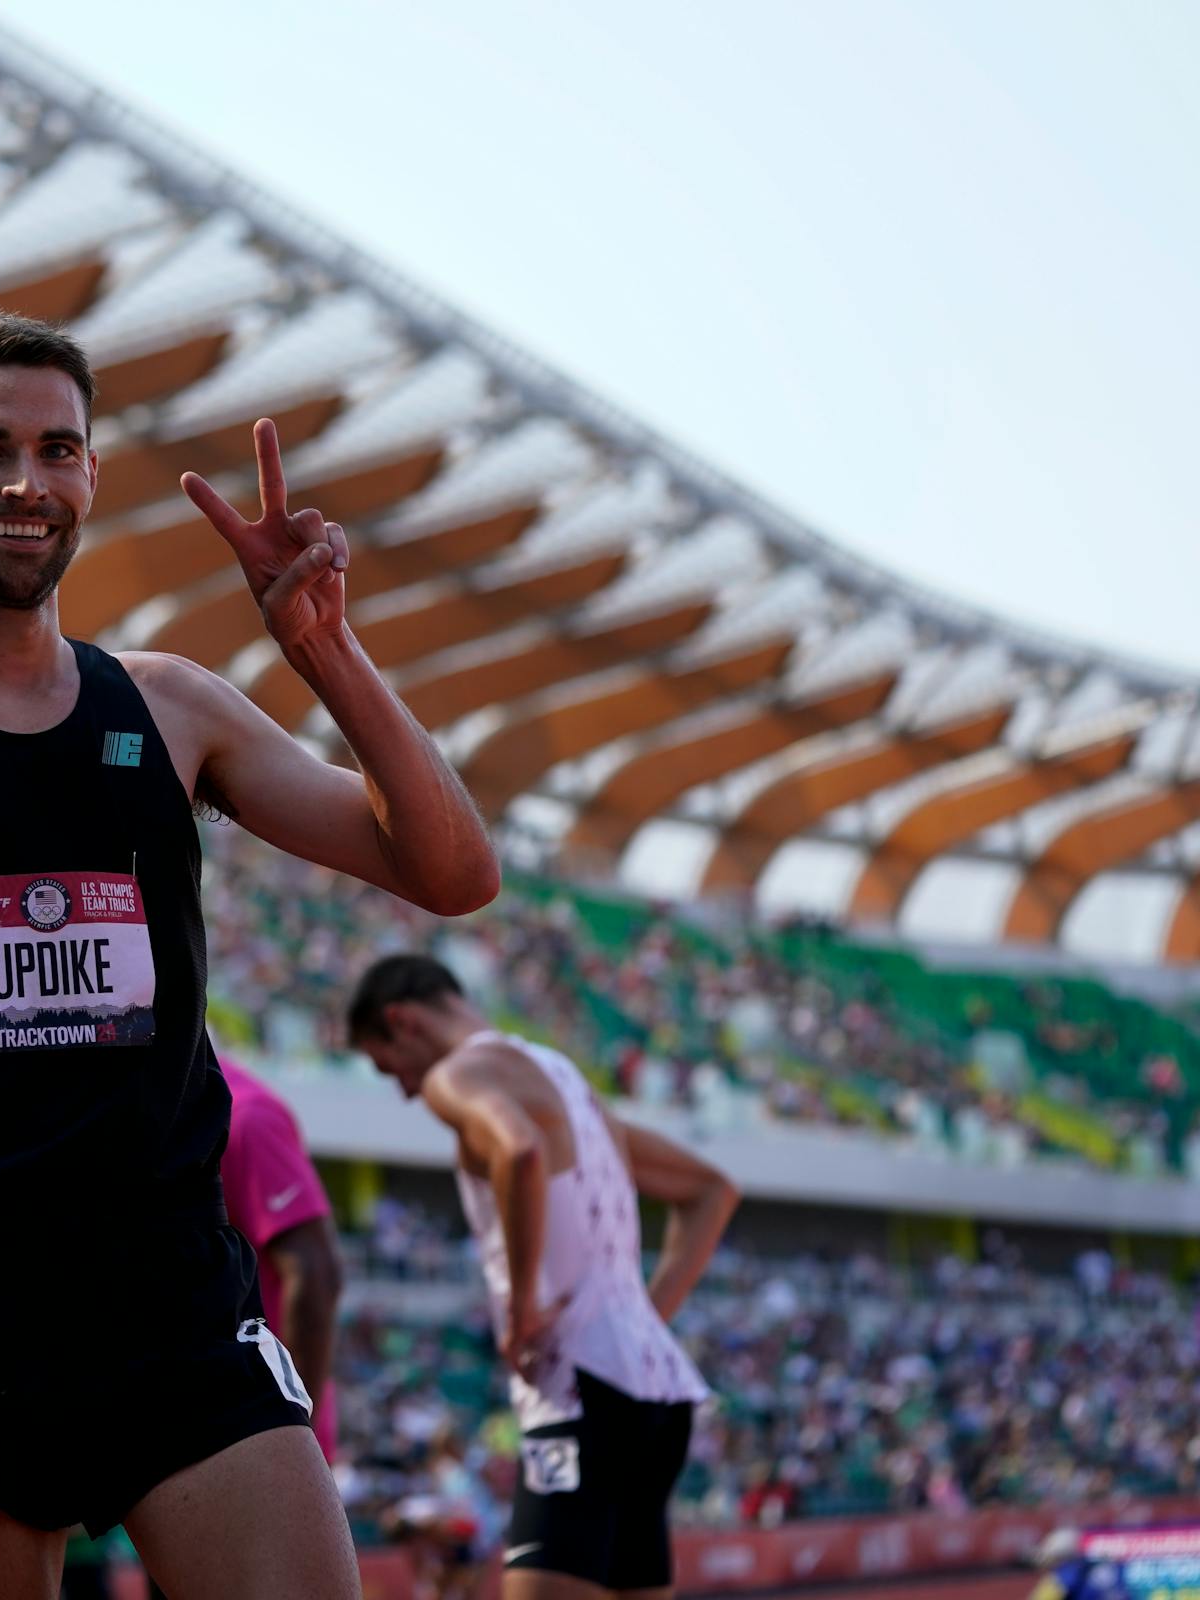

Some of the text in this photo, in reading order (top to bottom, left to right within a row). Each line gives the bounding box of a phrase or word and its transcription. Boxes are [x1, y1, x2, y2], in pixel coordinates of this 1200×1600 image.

[81, 882, 134, 898] U.S. OLYMPIC
[82, 897, 136, 912] TEAM TRIALS
